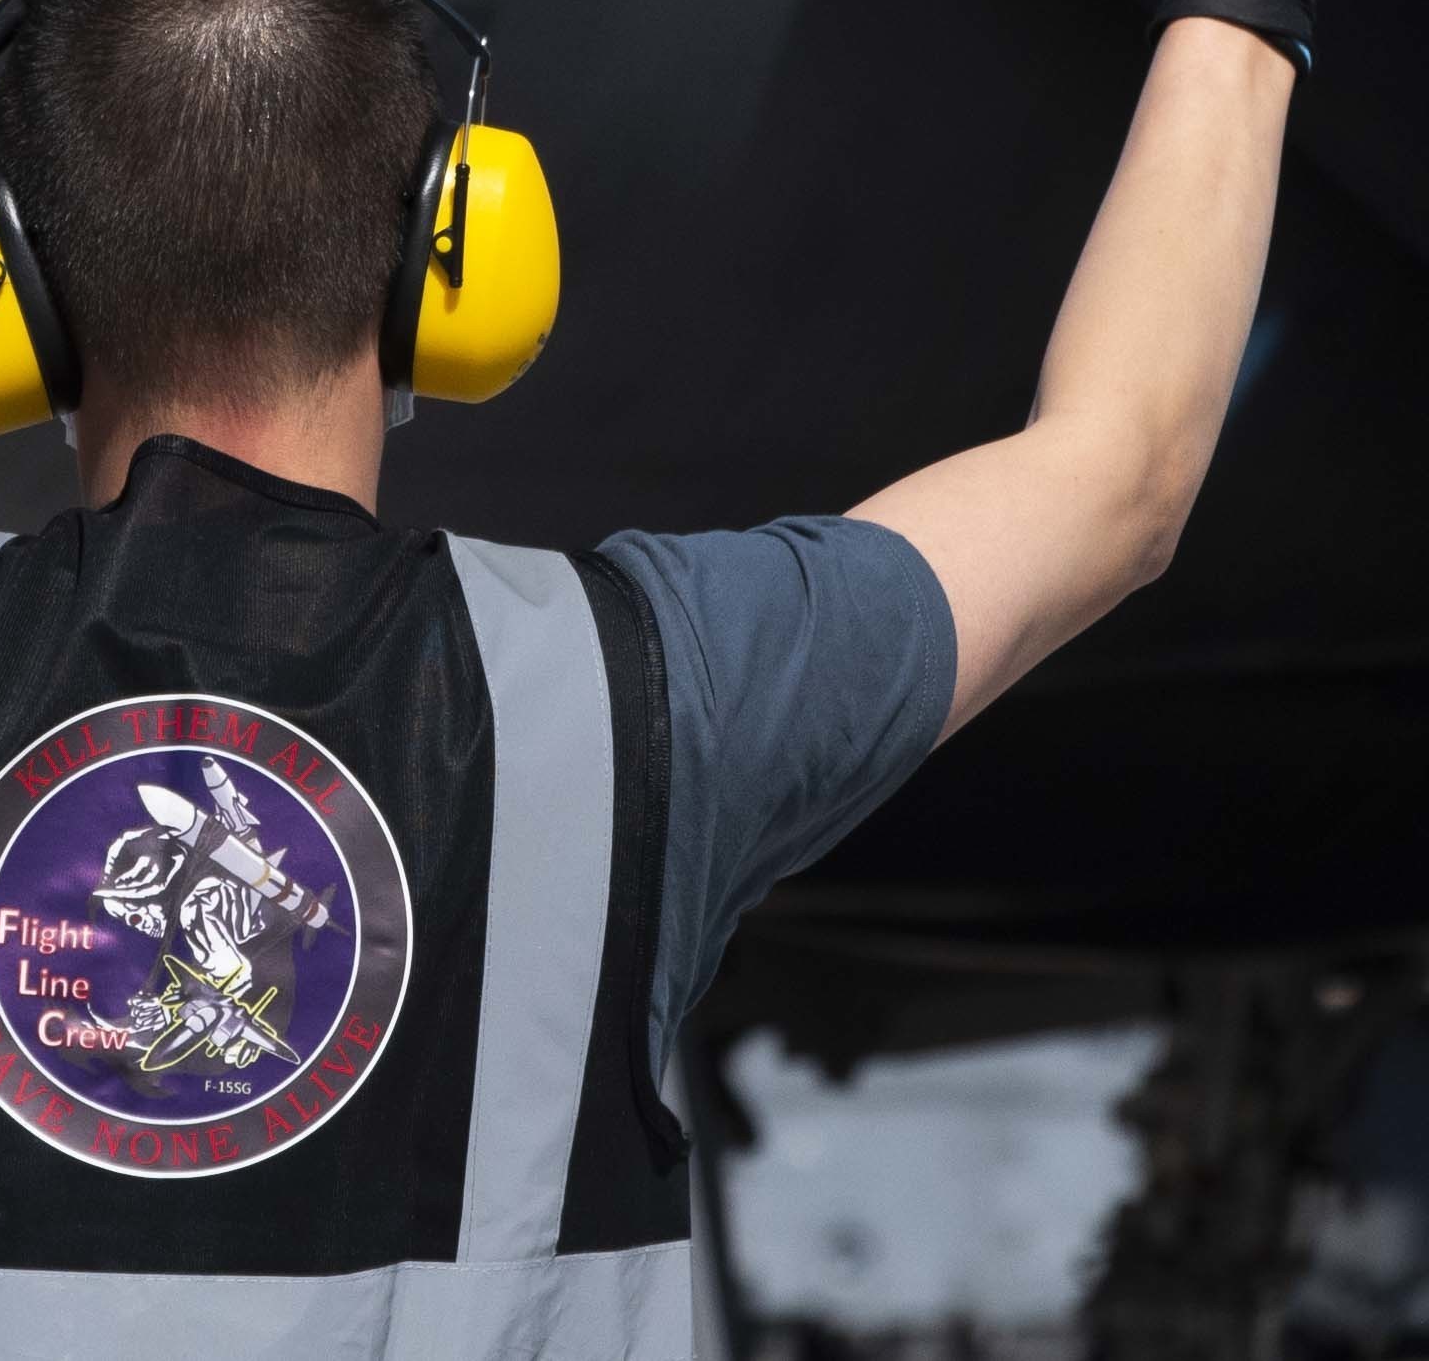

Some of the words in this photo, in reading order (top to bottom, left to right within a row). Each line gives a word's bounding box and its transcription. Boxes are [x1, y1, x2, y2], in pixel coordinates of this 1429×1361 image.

[14, 723, 111, 798] KILL
[122, 707, 263, 754] THEM
[268, 740, 344, 815] ALL
[18, 959, 89, 1000] Line
[37, 1009, 129, 1051] Crew
[89, 1120, 240, 1166] NONE
[262, 1014, 381, 1142] ALIVE
[204, 1079, 252, 1095] F-15SG
